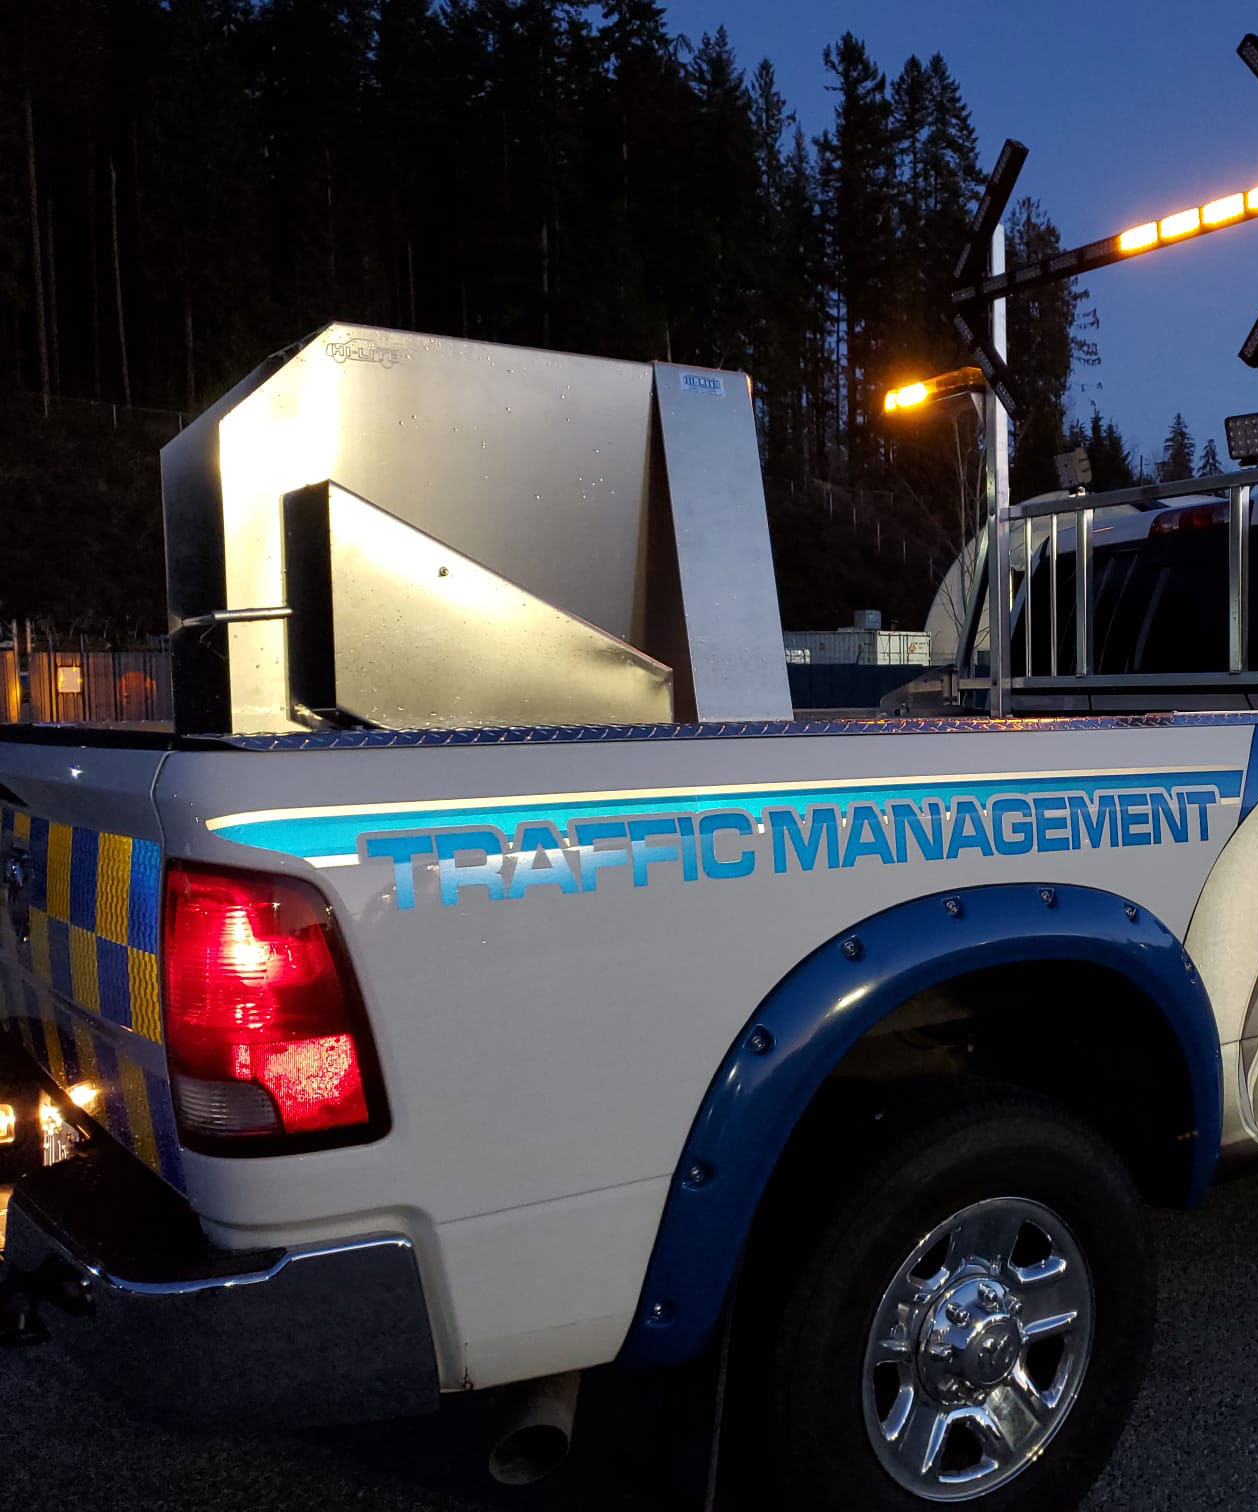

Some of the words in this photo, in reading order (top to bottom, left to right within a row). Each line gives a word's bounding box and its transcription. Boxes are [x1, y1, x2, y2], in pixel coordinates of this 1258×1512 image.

[331, 343, 399, 363] HI-LITE
[367, 812, 756, 910] TRAFFIC
[767, 791, 1218, 874] MANAGEMENT
